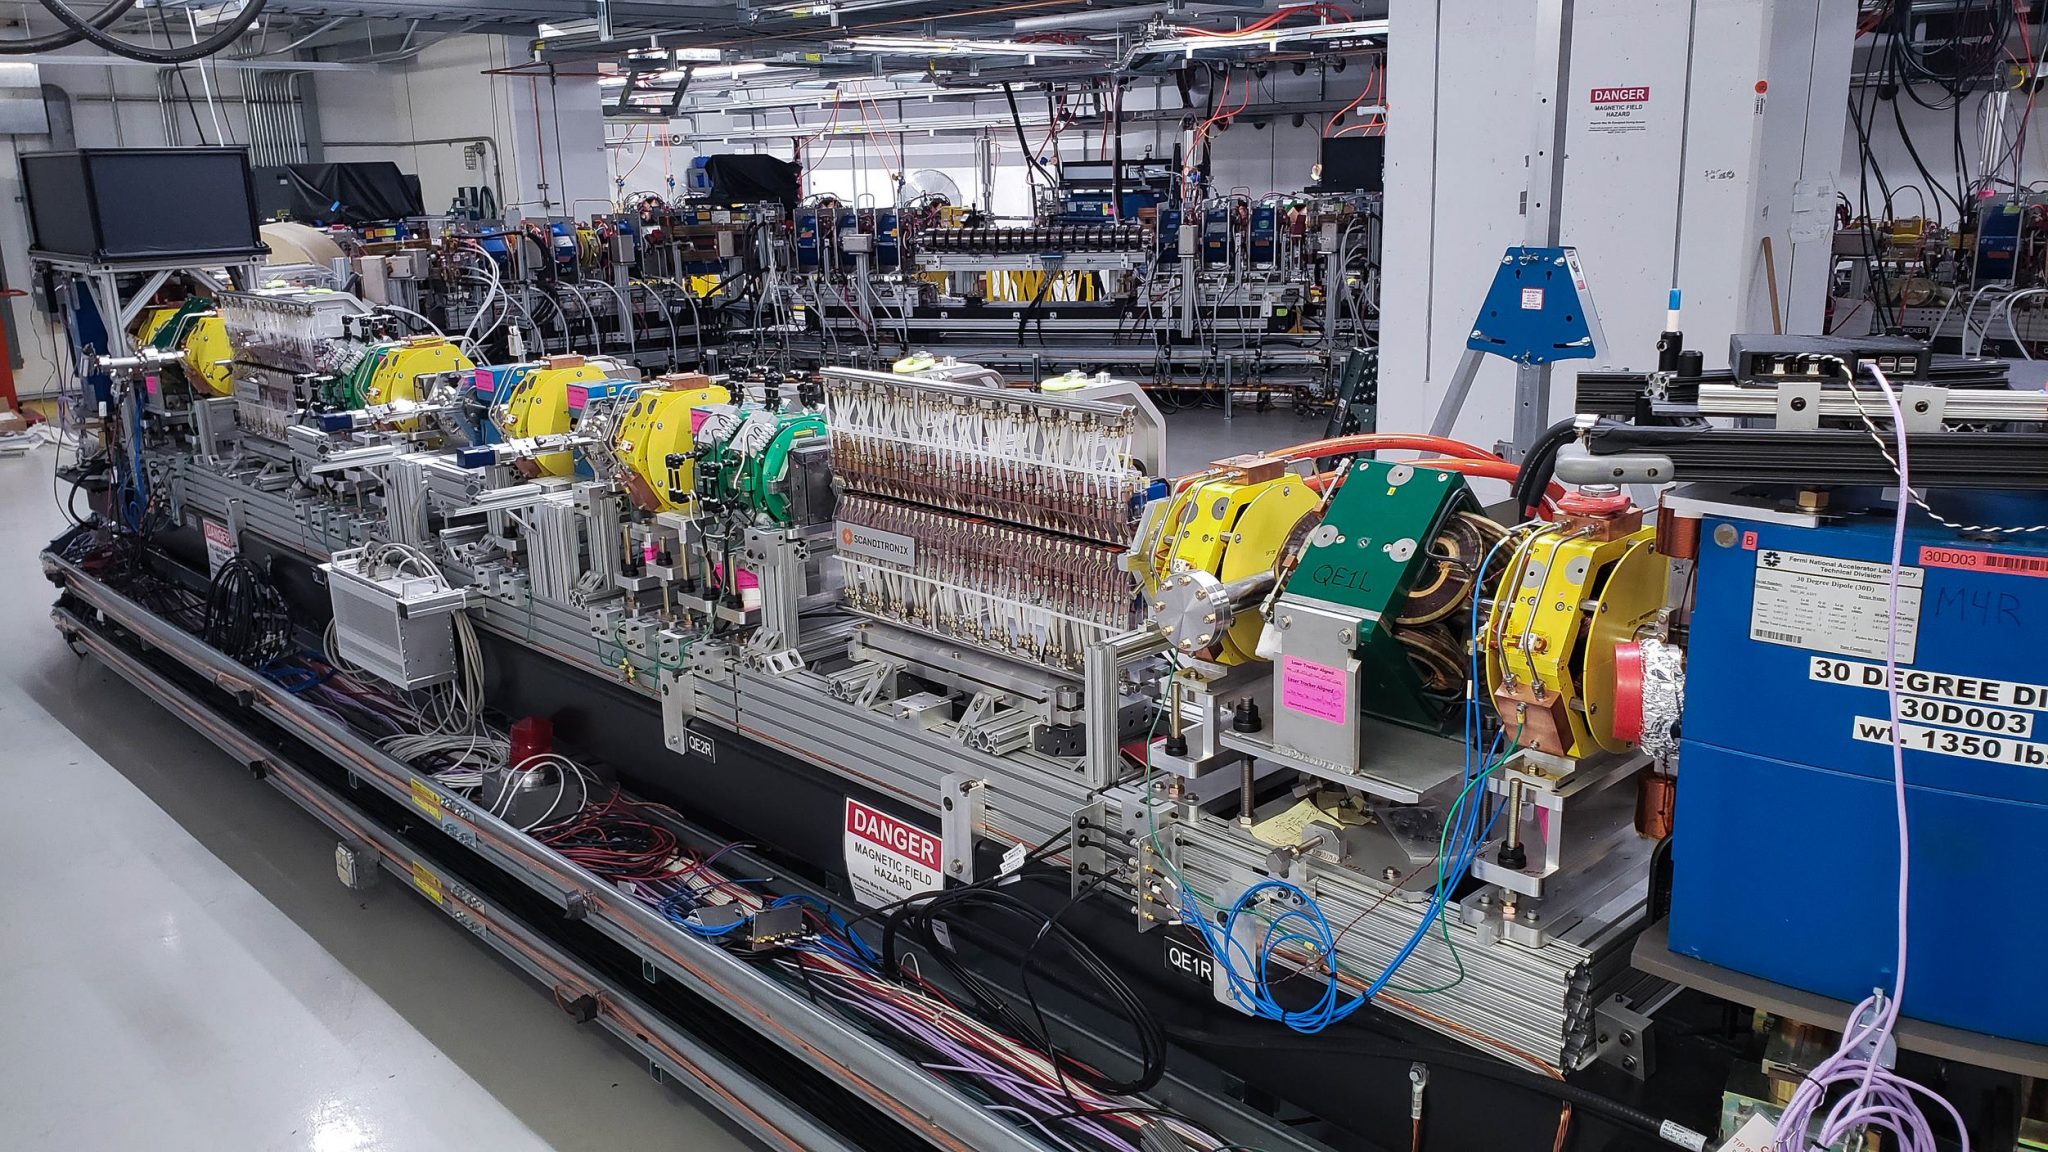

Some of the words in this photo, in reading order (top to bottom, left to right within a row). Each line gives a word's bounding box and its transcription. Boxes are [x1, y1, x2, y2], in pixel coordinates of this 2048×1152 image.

[1594, 89, 1646, 101] DANGER
[854, 534, 909, 556] SCANDITRONIX
[1789, 555, 1808, 564] Fermi
[1808, 558, 1837, 568] National
[1837, 562, 1878, 573] Accelerator
[1878, 567, 1918, 579] Labatory
[1925, 550, 1977, 566] 30D003
[1806, 577, 1831, 587] Degree
[1831, 581, 1854, 590] Dipole
[1854, 584, 1876, 593] (30D)
[1820, 566, 1853, 576] Technical
[1853, 570, 1882, 580] Division
[1935, 586, 2021, 627] M4R
[1319, 668, 1335, 676] Aligned
[1814, 659, 1851, 682] 30
[1862, 666, 2001, 702] DEGREE
[1900, 698, 2027, 734] 30D003
[689, 735, 712, 757] QE2R
[1921, 730, 2002, 759] 1350
[2014, 743, 2048, 765] lb
[854, 808, 935, 865] DANGER
[854, 841, 902, 872] MAGNETIC
[904, 865, 932, 886] FIELD
[873, 864, 912, 891] HAZARD
[1169, 947, 1213, 981] QE1R
